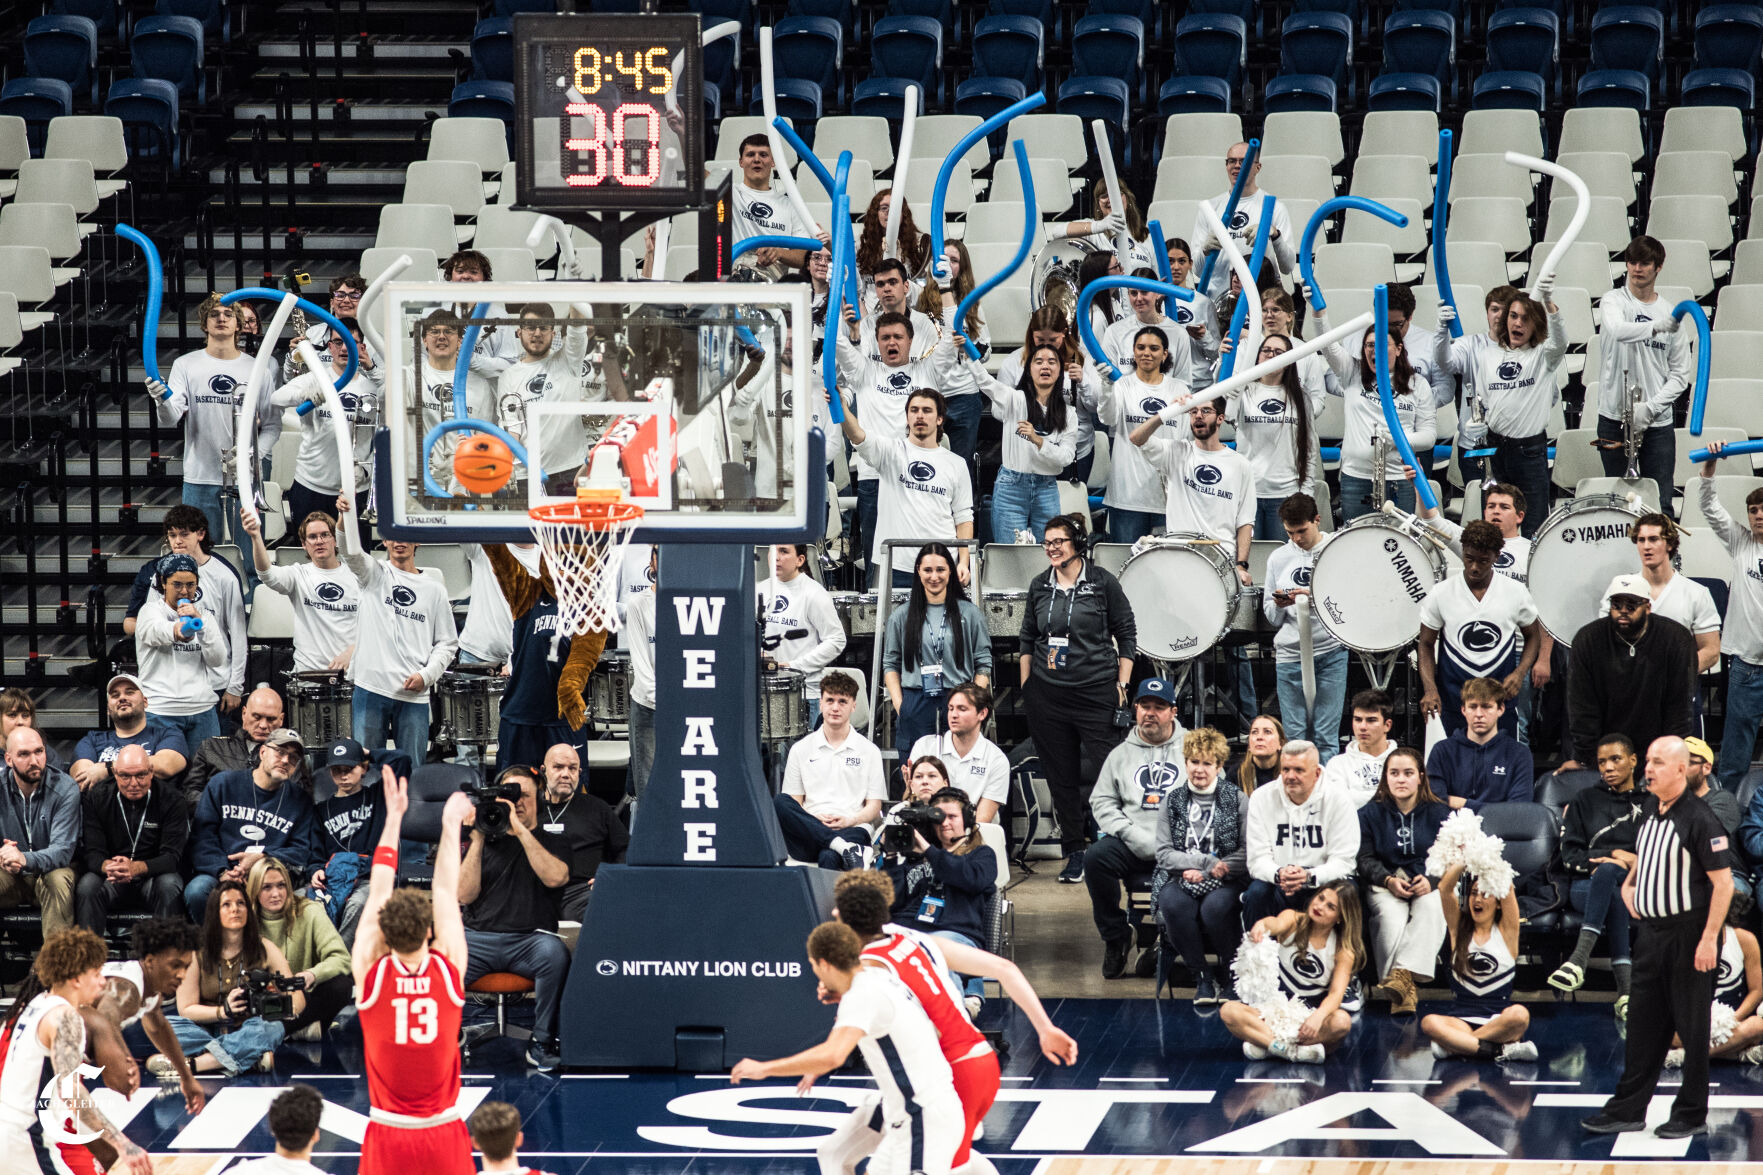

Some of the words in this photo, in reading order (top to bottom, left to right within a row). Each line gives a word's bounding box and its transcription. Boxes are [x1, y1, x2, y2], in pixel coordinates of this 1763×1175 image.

[574, 47, 671, 94] 8:45
[565, 103, 661, 187] 30
[1518, 377, 1535, 388] BAND
[195, 396, 232, 405] BASKETBALL
[1244, 416, 1283, 425] BASKETBALL
[1217, 489, 1234, 501] BAND
[406, 515, 447, 525] SPALDING
[1391, 551, 1427, 605] YAMAHA
[410, 611, 426, 623] BAND
[781, 617, 798, 627] BAND
[1326, 603, 1342, 625] REMO
[1174, 640, 1196, 651] REMO
[616, 689, 625, 716] YAMAHA
[474, 709, 484, 737] YAMAHA
[846, 757, 861, 766] PSU
[971, 765, 987, 775] PSU
[681, 717, 719, 861] ARE
[222, 804, 257, 821] PENN
[256, 811, 294, 834] STATE
[324, 811, 352, 835] PENN
[622, 961, 700, 976] NITTANY
[703, 961, 747, 977] LION
[751, 961, 802, 978] CLUB
[395, 976, 431, 994] TILLY
[390, 997, 438, 1045] 13
